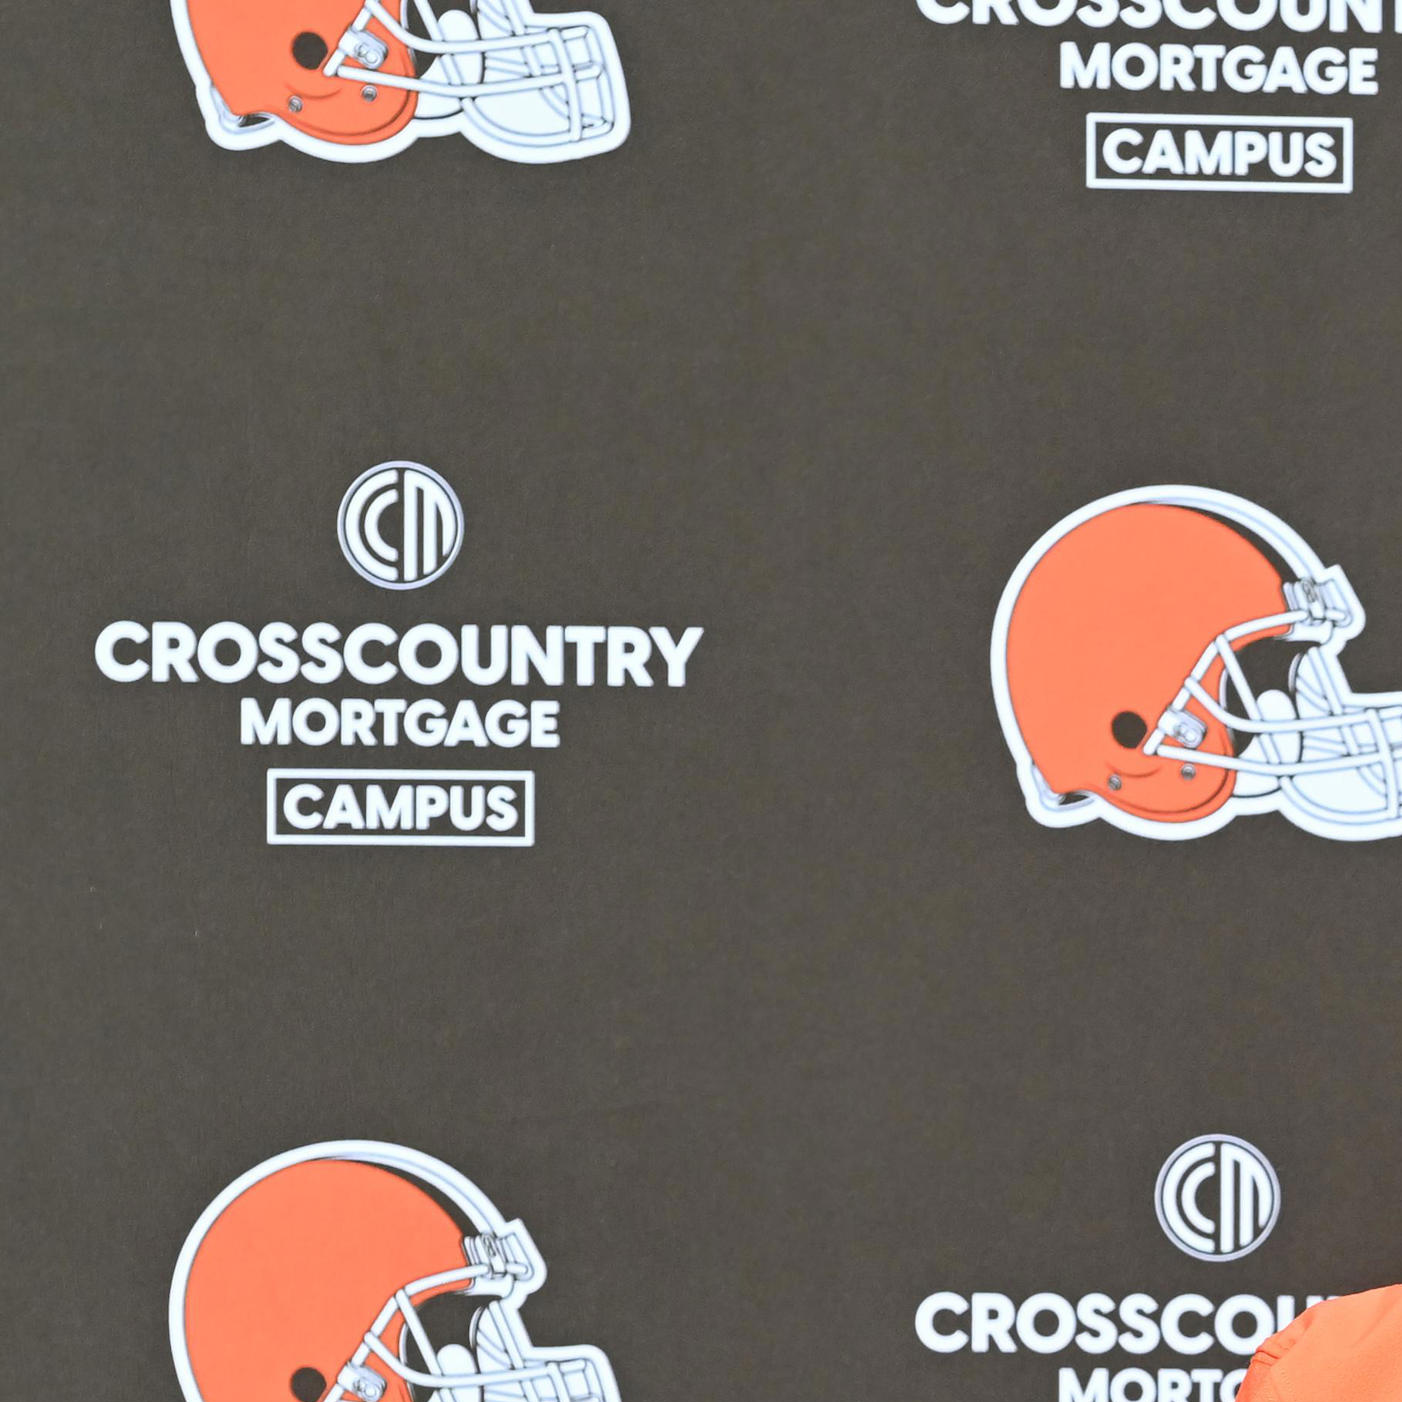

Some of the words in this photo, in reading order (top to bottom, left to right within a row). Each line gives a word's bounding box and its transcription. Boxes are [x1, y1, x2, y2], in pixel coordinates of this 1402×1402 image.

[1059, 40, 1379, 96] MORTGAGE
[1101, 128, 1338, 178] CAMPUS
[94, 620, 705, 688] CROSSCOUNTRY
[240, 697, 561, 748] MORTGAGE
[282, 783, 519, 832] CAMPUS
